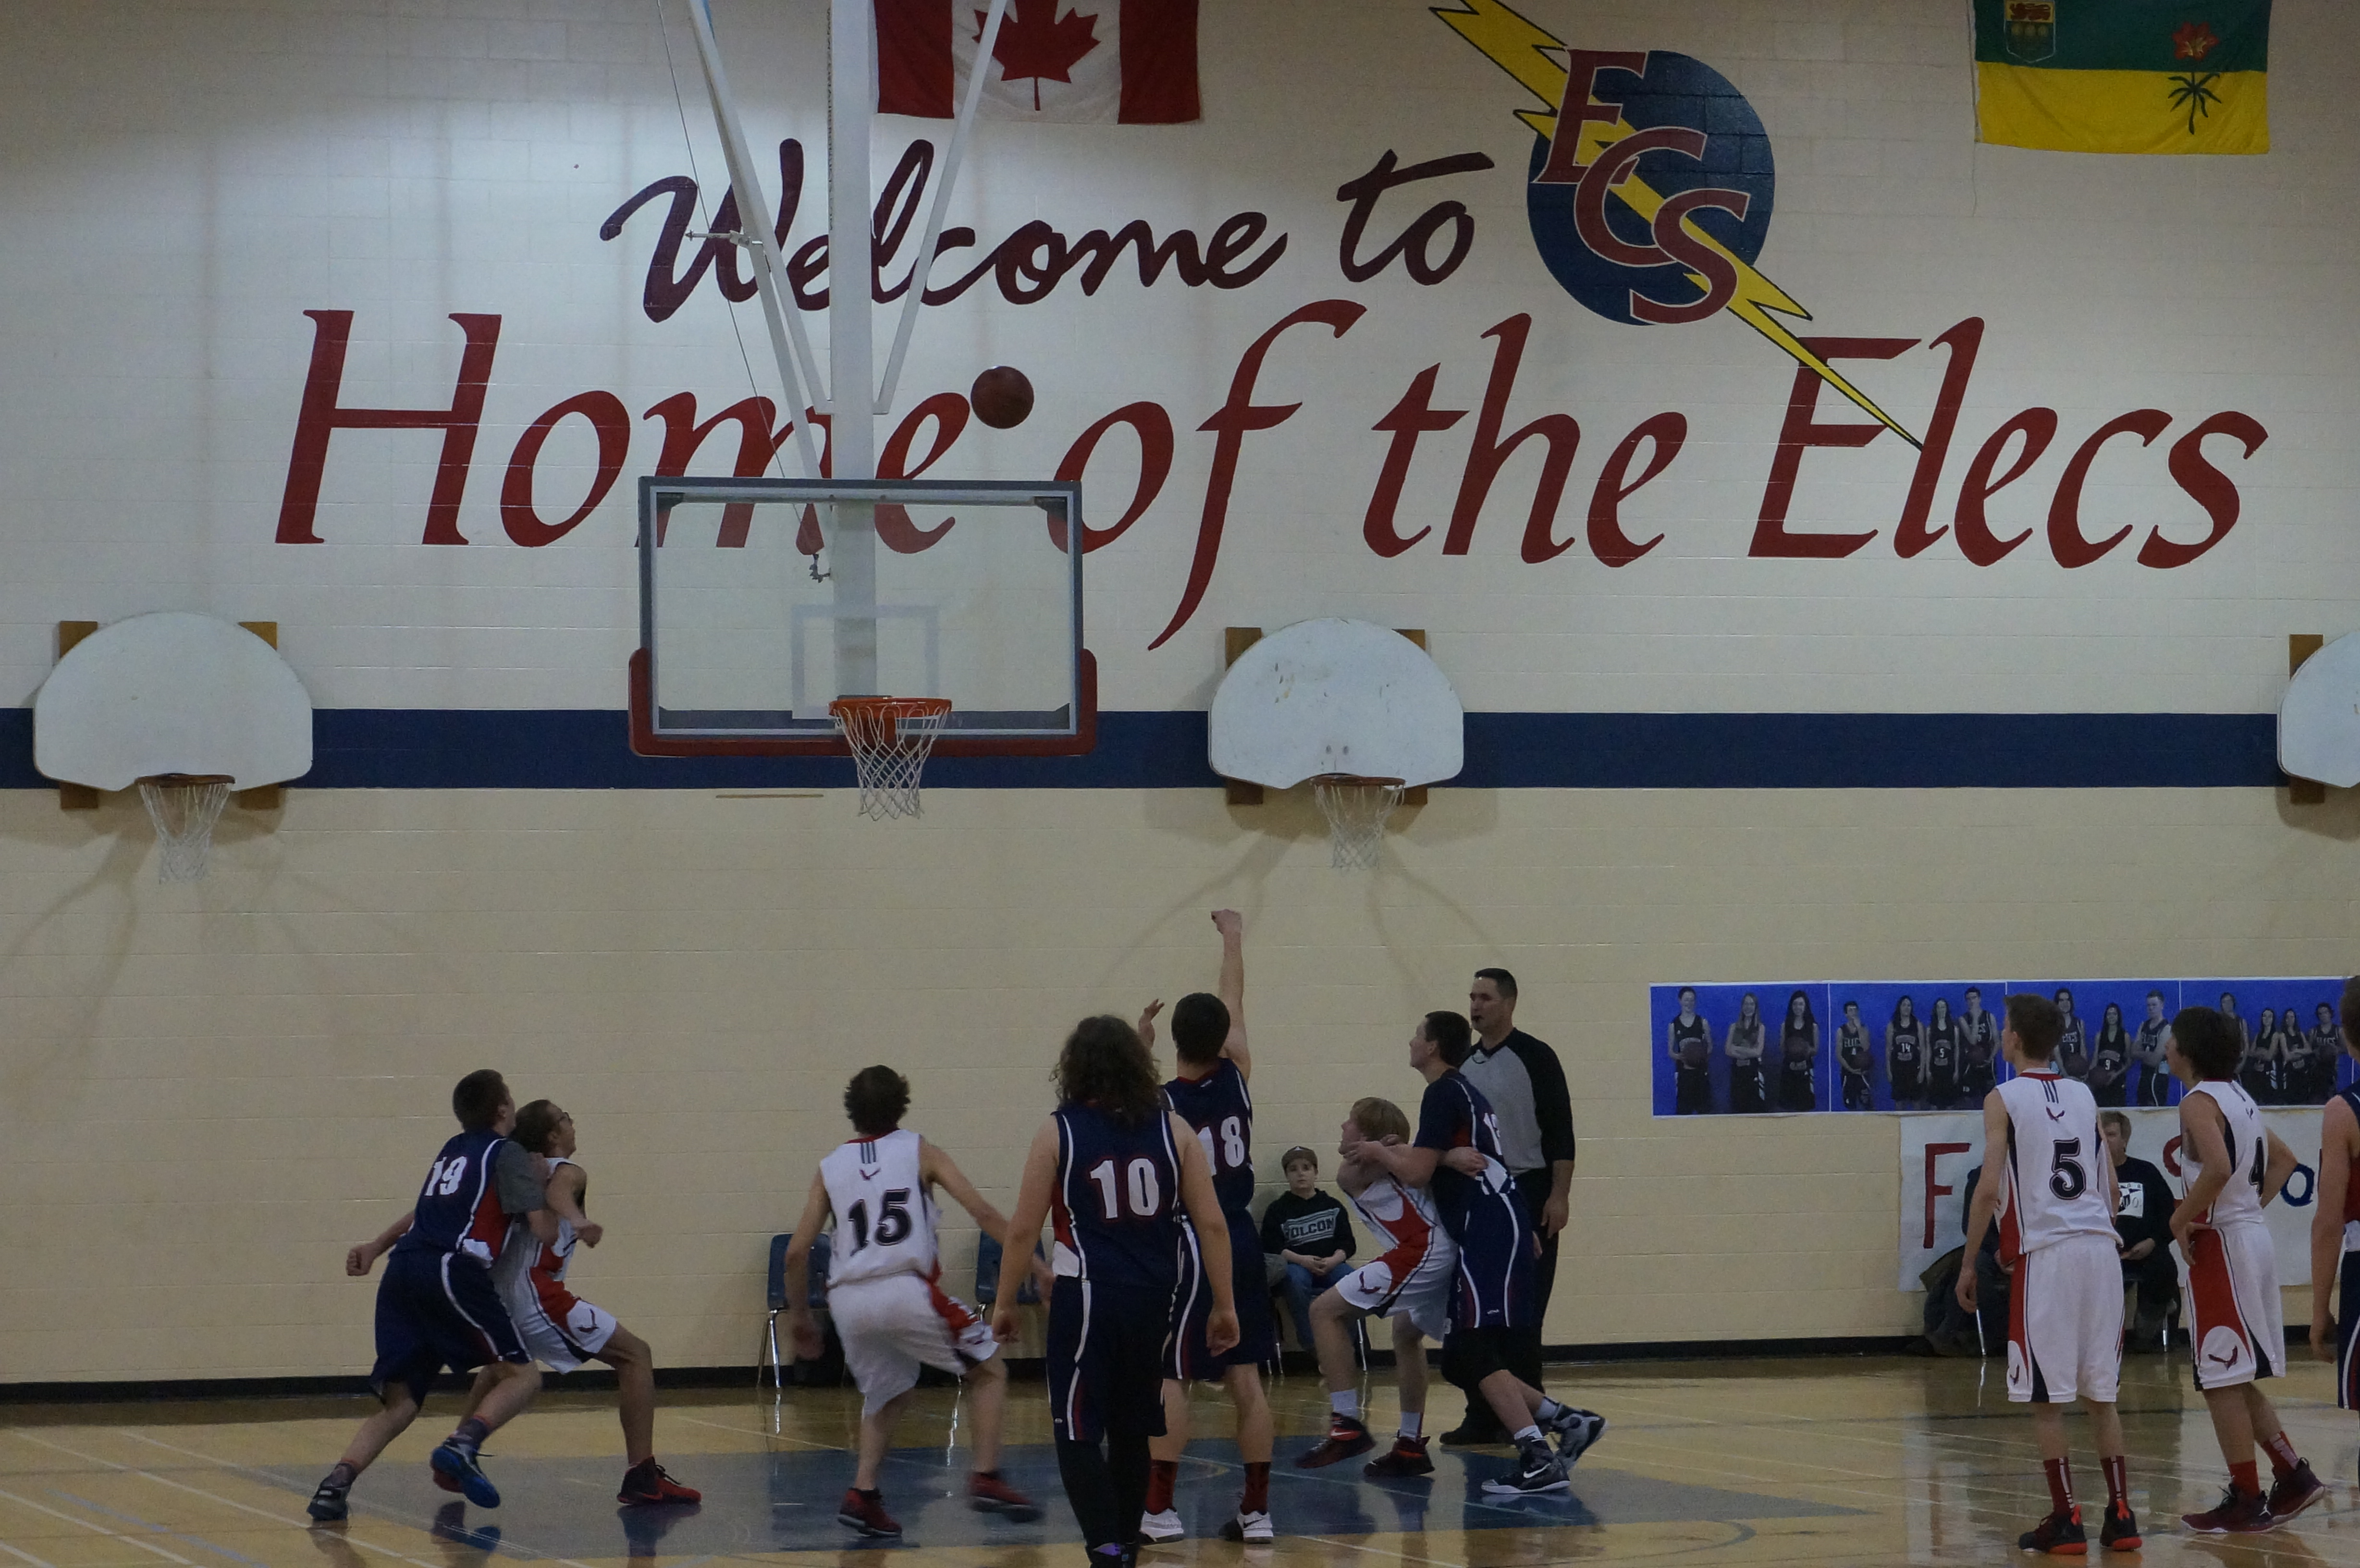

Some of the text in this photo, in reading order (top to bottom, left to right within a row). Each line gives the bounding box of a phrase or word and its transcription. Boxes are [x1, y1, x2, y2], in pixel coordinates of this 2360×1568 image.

[1531, 49, 1752, 326] ECS
[600, 138, 1495, 322] Welcome to
[275, 299, 2269, 650] Home of the Elecs
[425, 1155, 467, 1197] 19
[1197, 1115, 1244, 1176] 18
[2049, 1137, 2087, 1200] 5
[848, 1188, 912, 1253] 15
[1090, 1158, 1160, 1219] 10
